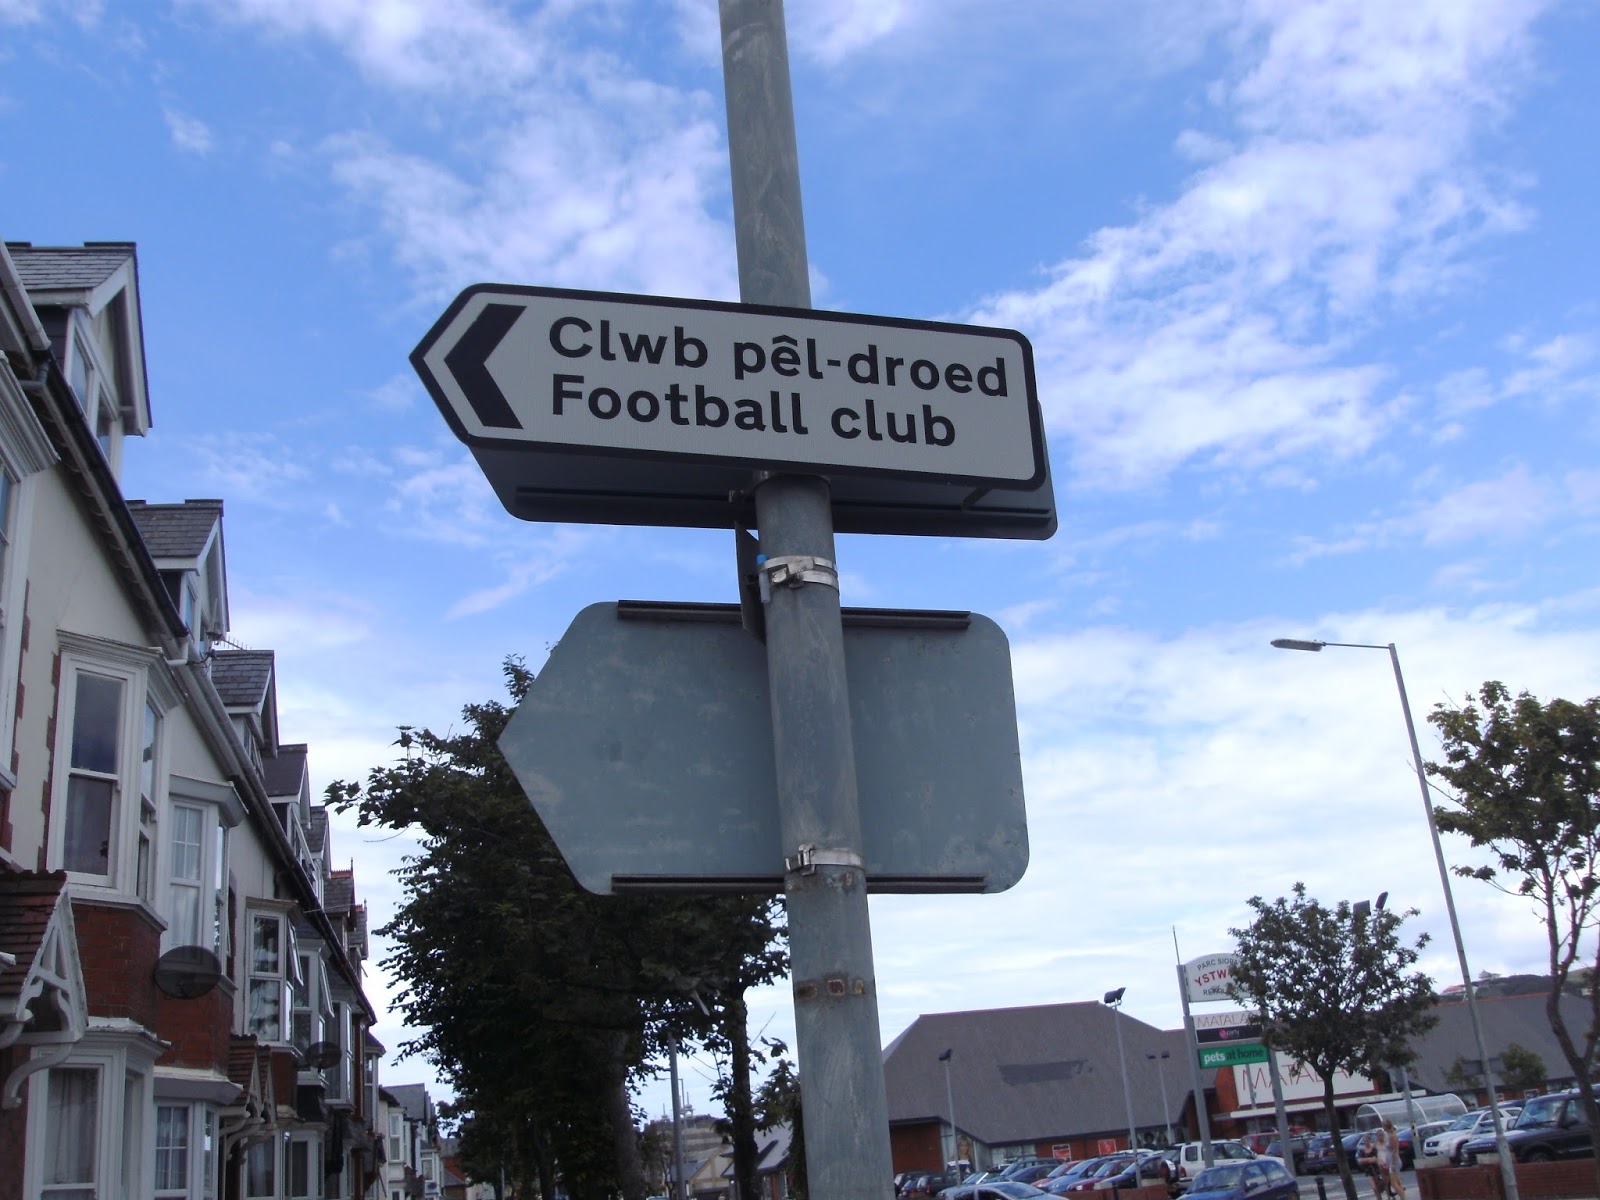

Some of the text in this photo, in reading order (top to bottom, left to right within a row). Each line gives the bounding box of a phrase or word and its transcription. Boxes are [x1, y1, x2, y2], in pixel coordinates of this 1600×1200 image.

[548, 316, 1008, 398] Clwb pêl-droed
[552, 373, 956, 447] Football club
[1197, 959, 1216, 971] PARC
[1194, 969, 1231, 986] YSTW
[1197, 1012, 1256, 1028] MATALA
[1203, 1048, 1263, 1065] pets at home
